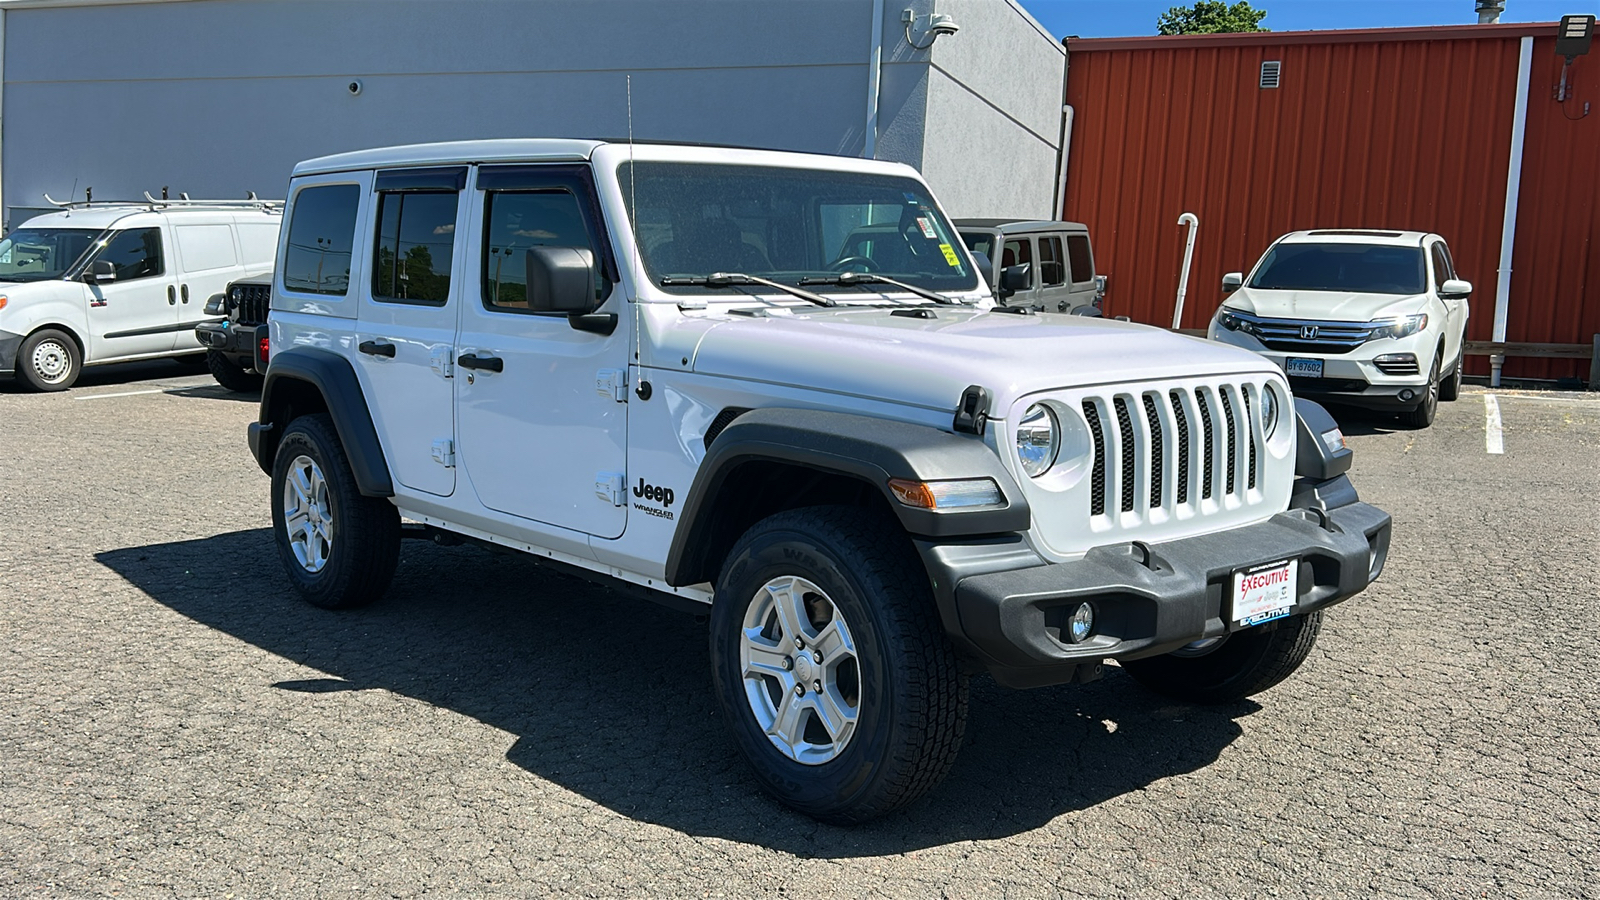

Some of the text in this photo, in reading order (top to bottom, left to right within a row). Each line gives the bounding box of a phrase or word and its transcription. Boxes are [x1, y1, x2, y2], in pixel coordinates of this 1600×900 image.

[633, 477, 674, 508] Jeep
[633, 502, 674, 517] WRANGLER
[1242, 569, 1289, 600] EXECUTIVE
[1240, 606, 1290, 626] EXECUTIVE
